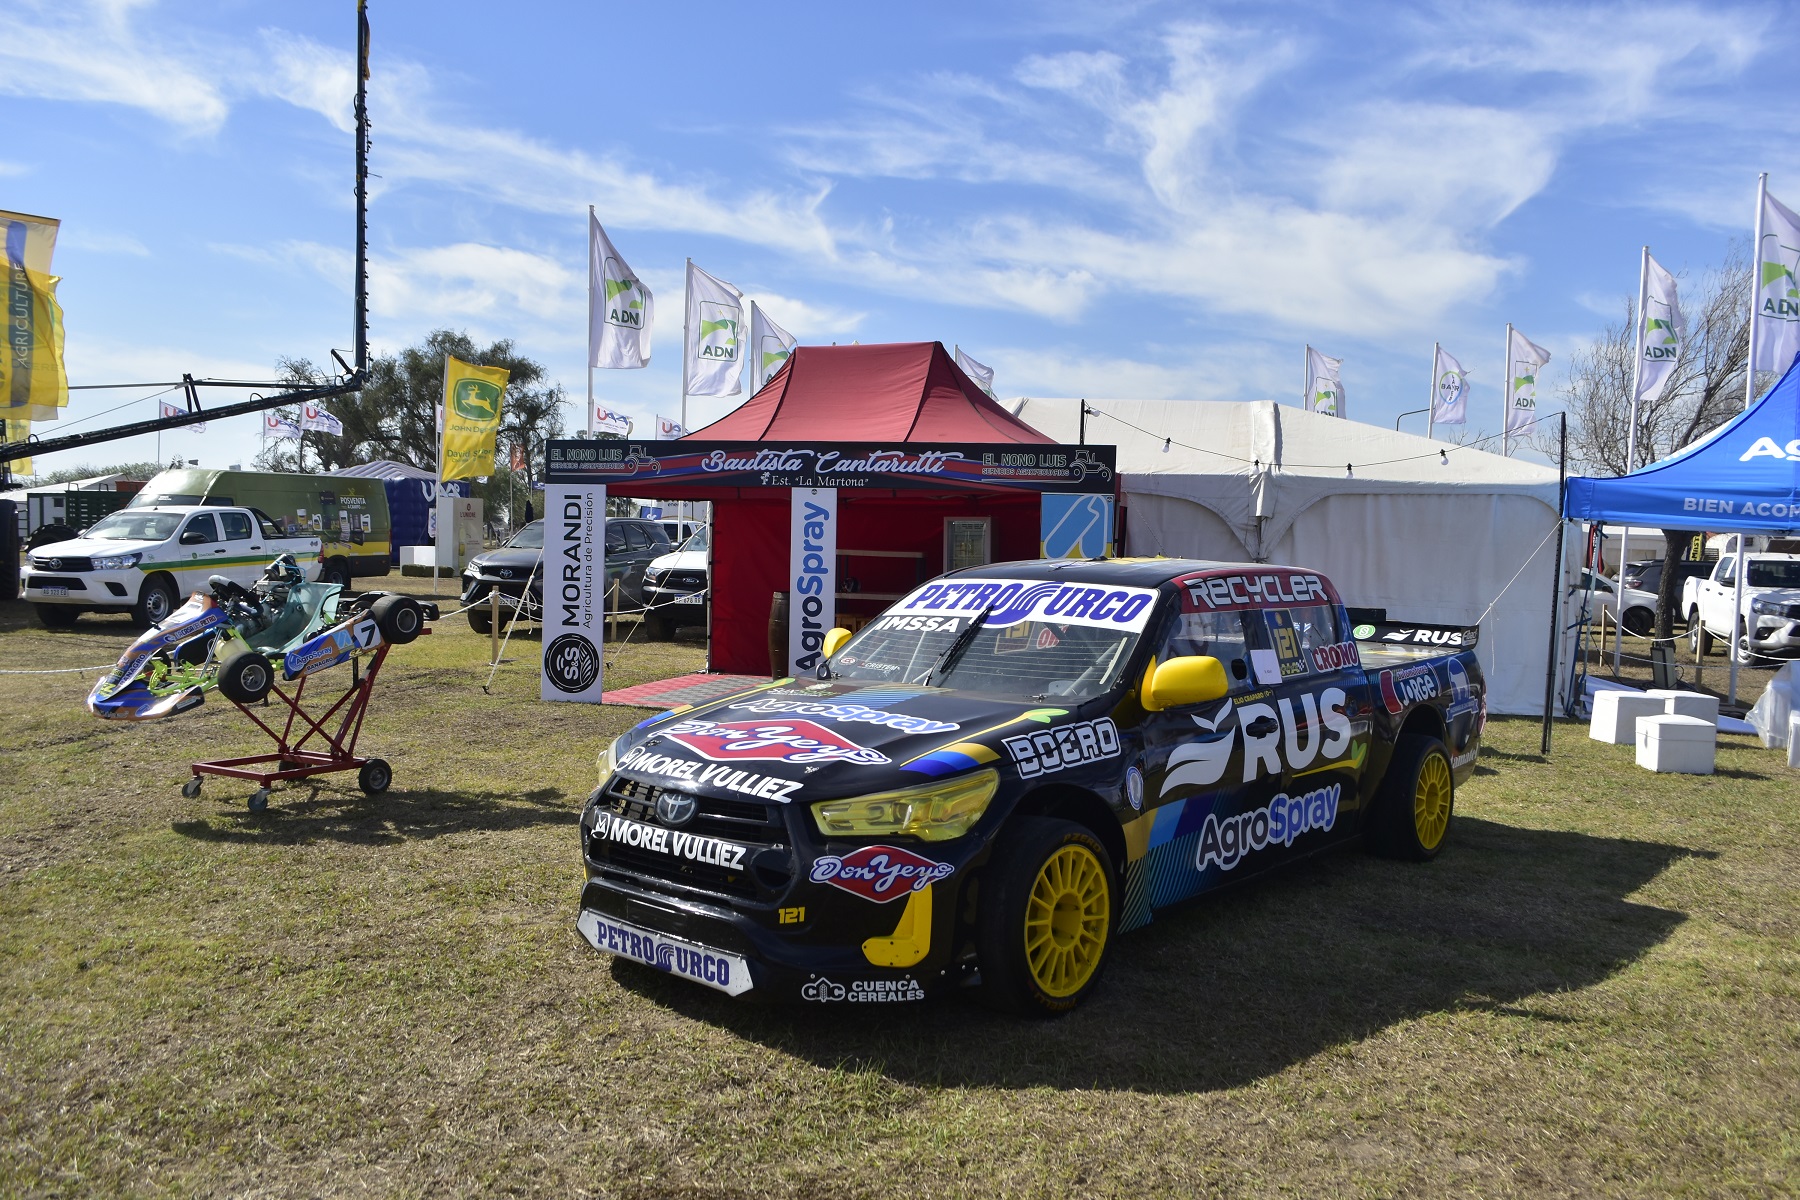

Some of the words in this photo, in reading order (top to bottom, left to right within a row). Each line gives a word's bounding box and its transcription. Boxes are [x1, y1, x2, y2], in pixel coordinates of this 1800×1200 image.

[14, 262, 29, 369] AGRICULTURE
[610, 308, 639, 326] ADN
[1763, 298, 1800, 317] ADN
[703, 344, 734, 359] ADN
[1645, 345, 1677, 359] ADN
[551, 449, 564, 460] EL
[567, 449, 597, 461] NONO
[599, 449, 623, 462] LUIS
[701, 449, 814, 472] Bautista
[983, 453, 998, 466] EL
[1001, 454, 1036, 467] NONO
[1039, 454, 1067, 467] LUIS
[771, 475, 791, 486] Est.
[1683, 497, 1734, 514] BIEN
[584, 492, 594, 545] Precisión
[562, 494, 582, 627] MORANDI
[584, 547, 593, 562] de
[583, 564, 594, 629] Agricultura
[796, 501, 830, 671] AgroSpray
[361, 624, 376, 647] 7
[1273, 628, 1299, 659] 121
[1413, 629, 1462, 645] RUS
[295, 646, 333, 667] AgroSpray
[1312, 640, 1359, 673] CRONO
[729, 699, 960, 734] AgroSpray
[1238, 687, 1352, 783] RUS
[1001, 717, 1122, 779] BOERO
[632, 752, 696, 781] MOREL
[696, 764, 804, 804] VULLIEZ
[1196, 782, 1342, 871] AgroSpray
[610, 816, 668, 853] MOREL
[672, 831, 748, 871] VULLIEZ
[809, 855, 870, 883] Don
[778, 906, 806, 924] 121
[847, 989, 925, 1002] CEREALES
[852, 980, 920, 992] CUENCA
